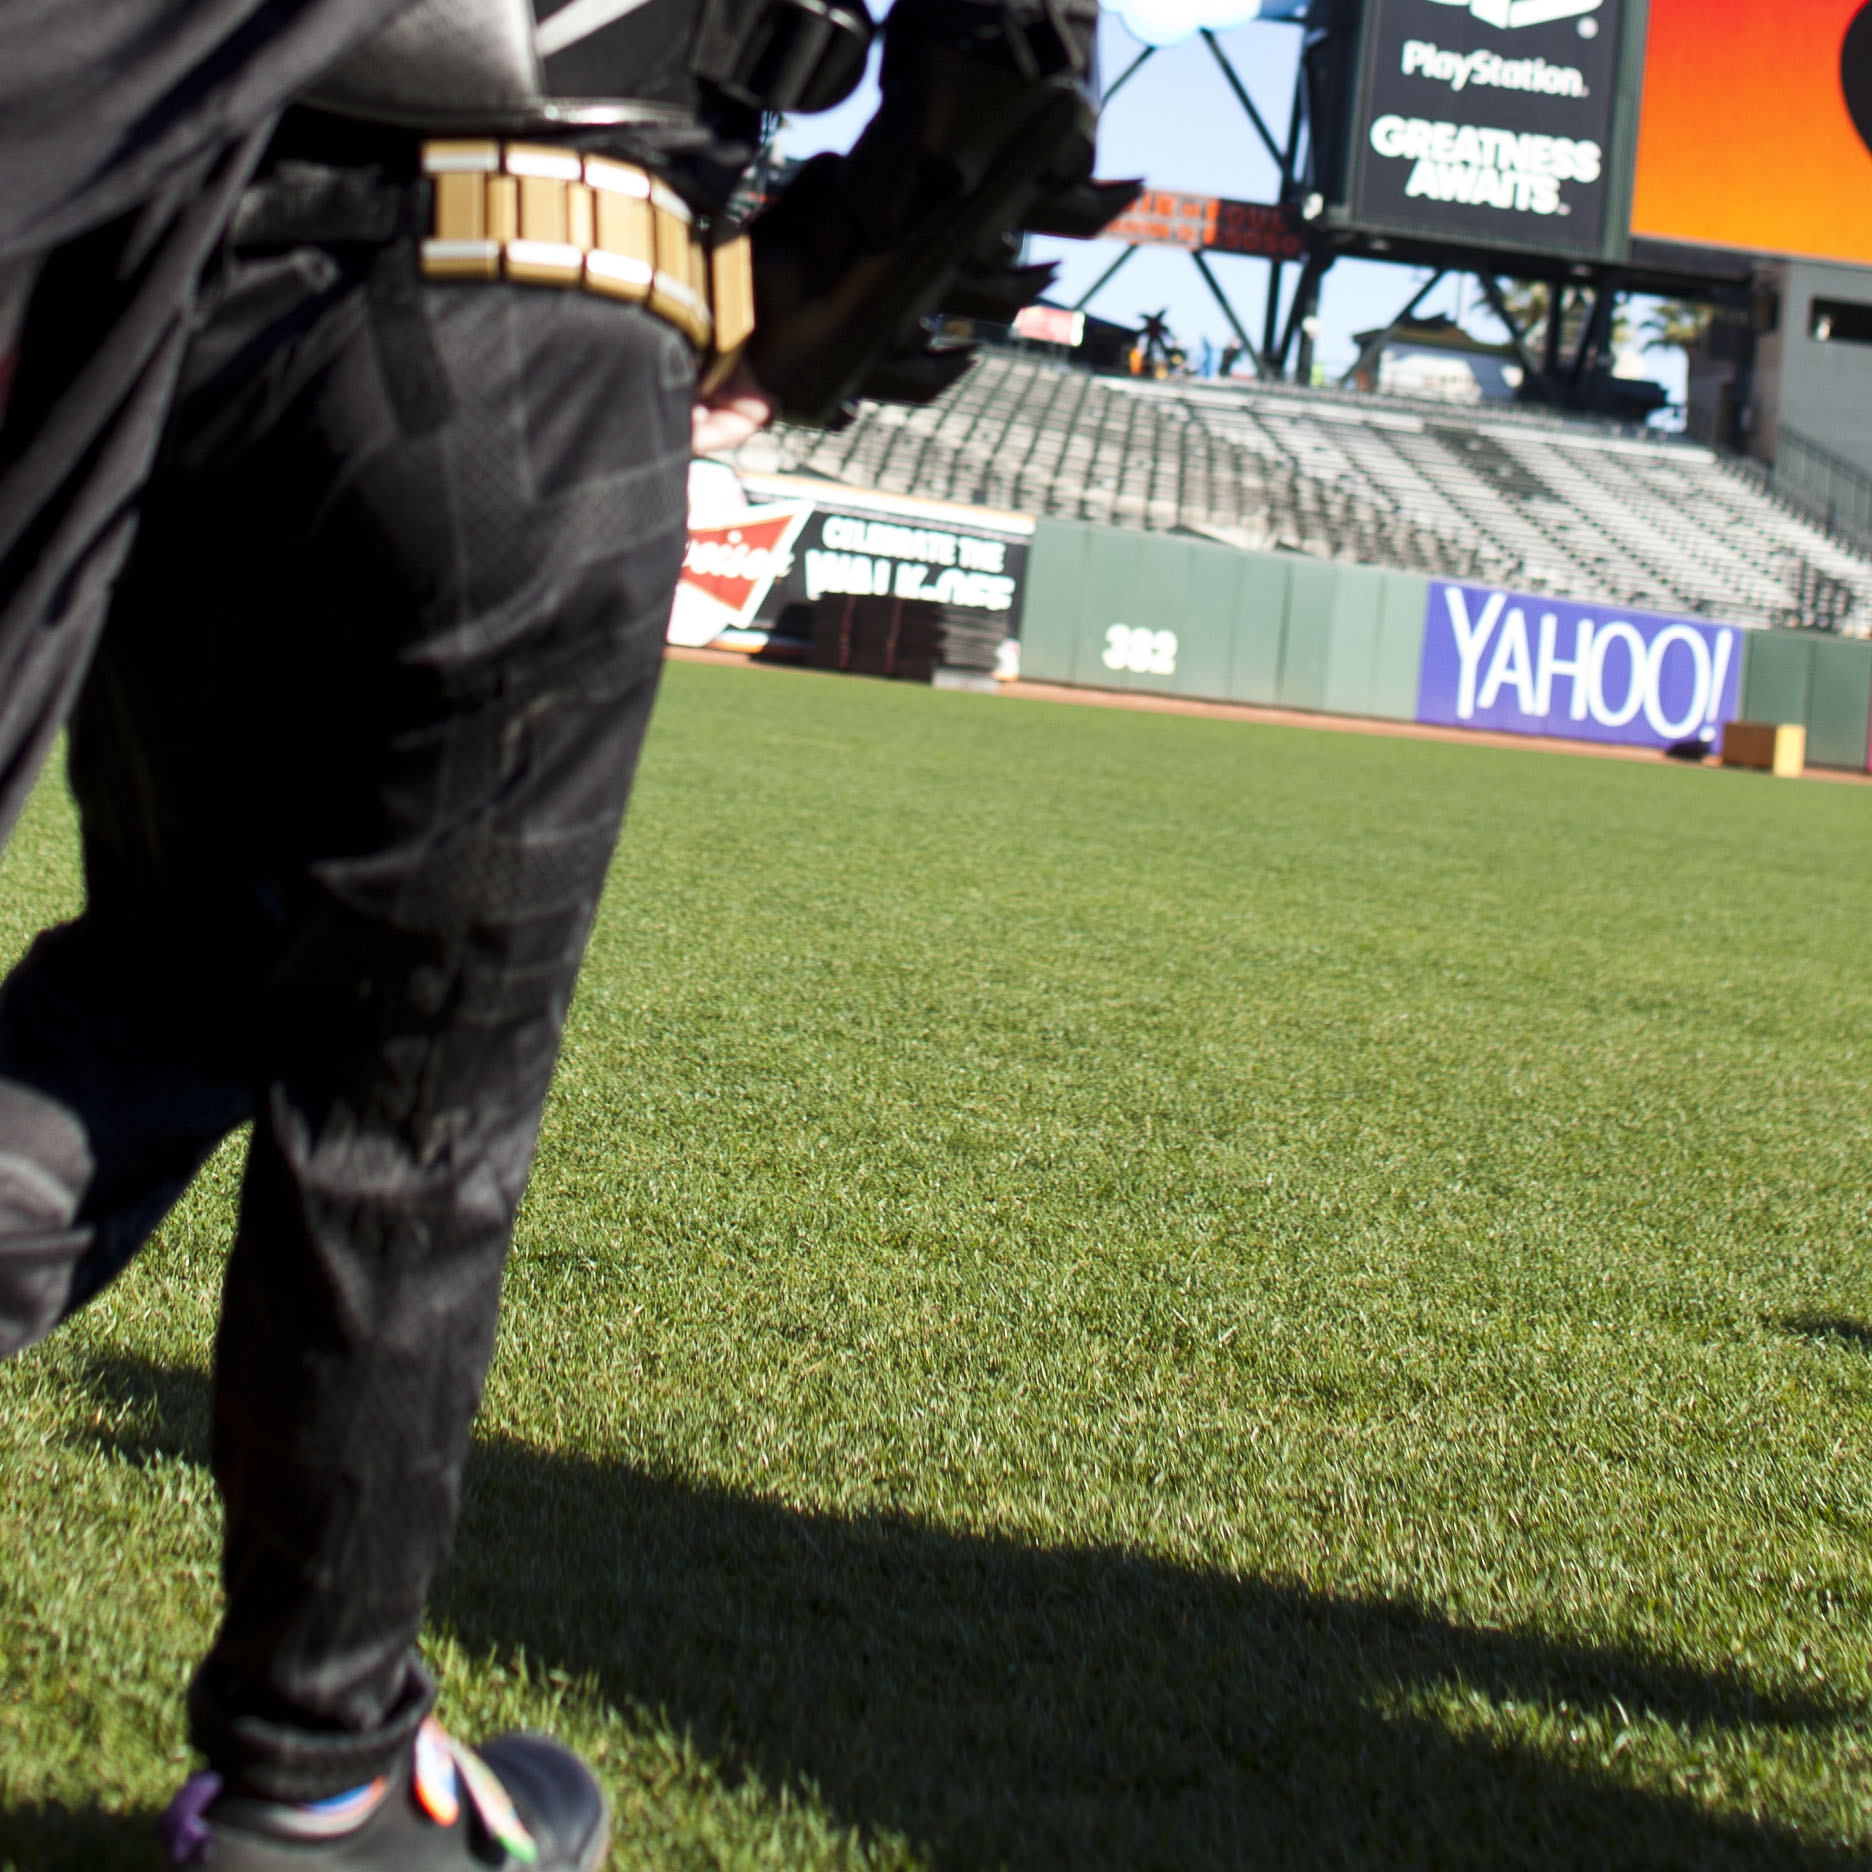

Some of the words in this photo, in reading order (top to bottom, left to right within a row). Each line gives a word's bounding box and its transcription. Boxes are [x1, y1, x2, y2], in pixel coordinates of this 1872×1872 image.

[1401, 39, 1585, 97] PlayStation
[1370, 114, 1602, 183] GREATNESS
[821, 514, 956, 564] CELEBRATE
[957, 536, 1006, 574] THE
[1444, 585, 1734, 742] YAHOO!
